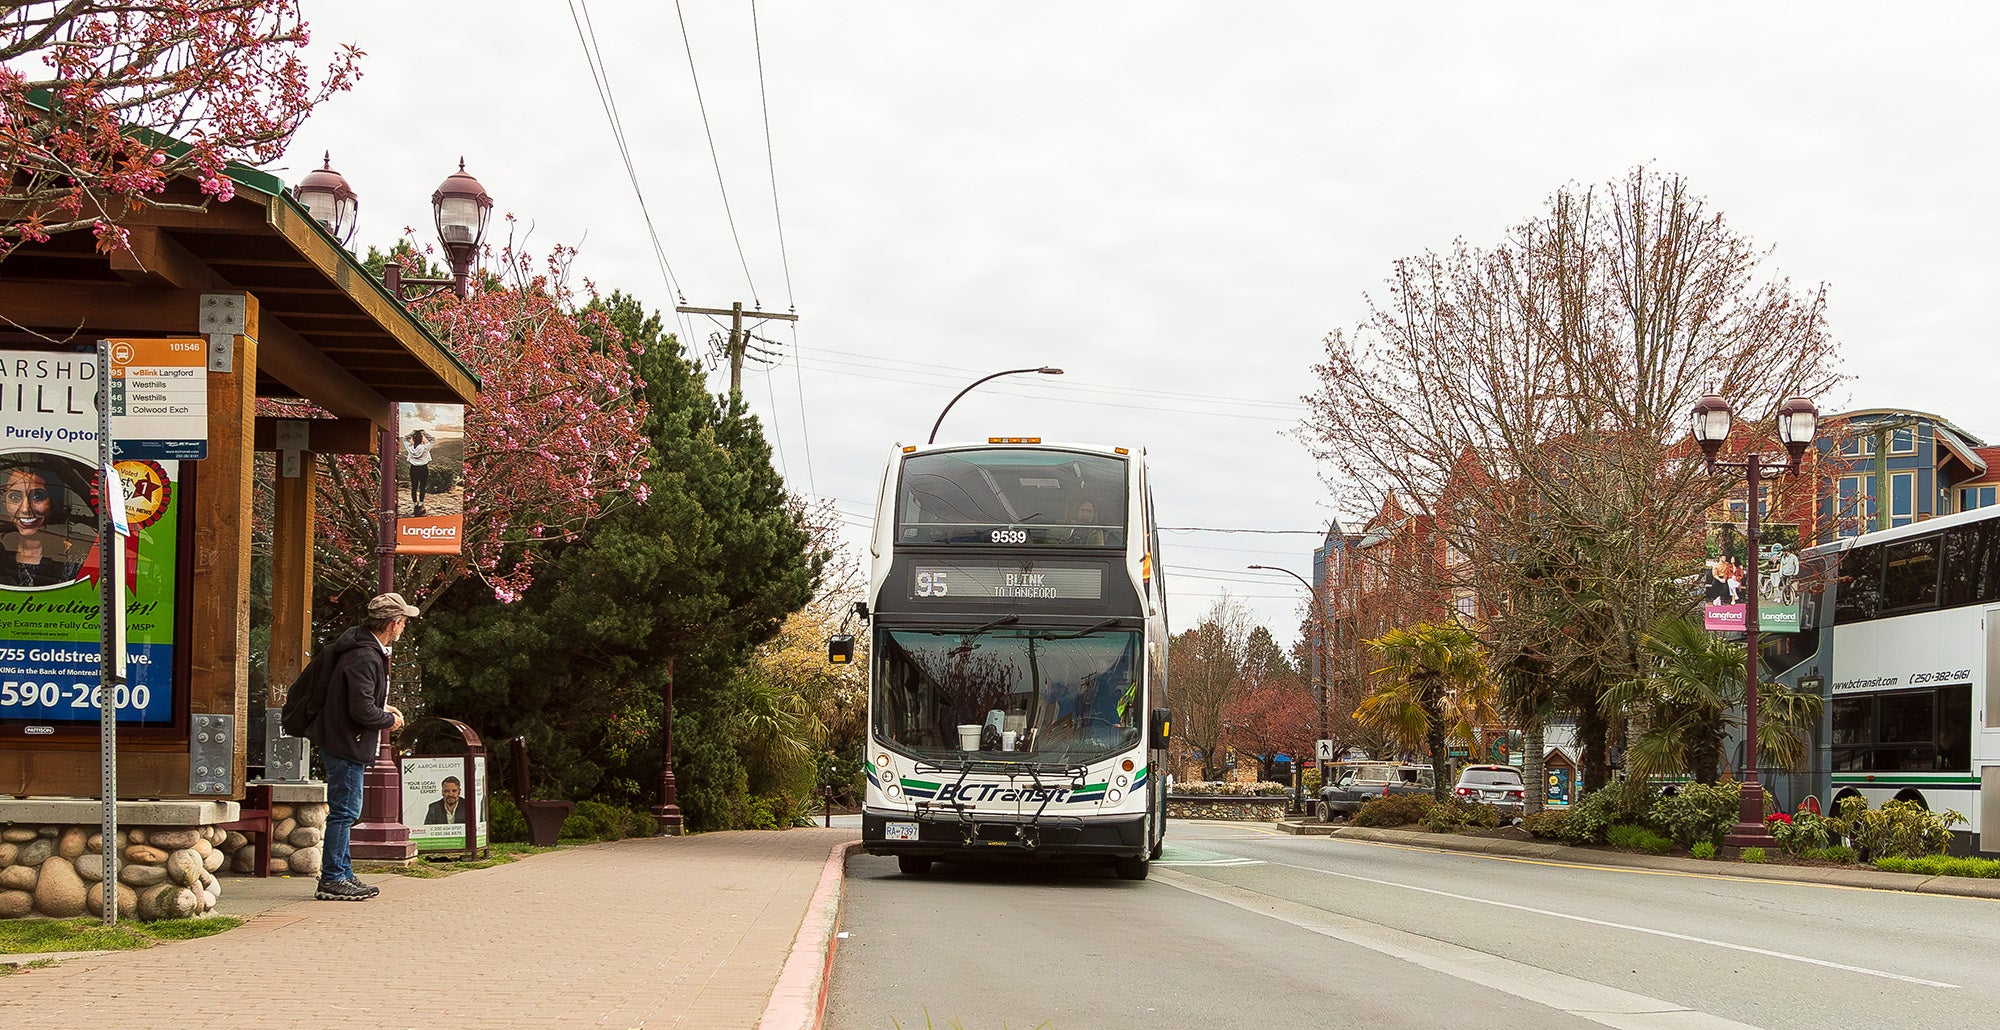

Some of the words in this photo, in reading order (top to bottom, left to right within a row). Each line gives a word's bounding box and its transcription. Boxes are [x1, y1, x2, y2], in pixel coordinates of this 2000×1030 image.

[169, 343, 201, 351] 101546
[140, 368, 159, 377] Blink
[159, 369, 194, 378] Langford
[132, 406, 167, 414] Colwood
[6, 426, 53, 442] Purely
[121, 468, 139, 477] Voted
[402, 525, 456, 539] Langford
[991, 530, 1027, 543] 9539
[917, 572, 948, 598] 95
[1006, 573, 1045, 587] BLINK
[994, 587, 1005, 597] TO
[1009, 587, 1057, 599] LANGFORD
[17, 596, 47, 614] for
[47, 600, 101, 620] voting
[1708, 611, 1742, 620] Langford
[1761, 612, 1796, 622] Langford
[13, 620, 42, 628] Exams
[59, 621, 80, 631] Fully
[29, 648, 101, 663] Goldstrea
